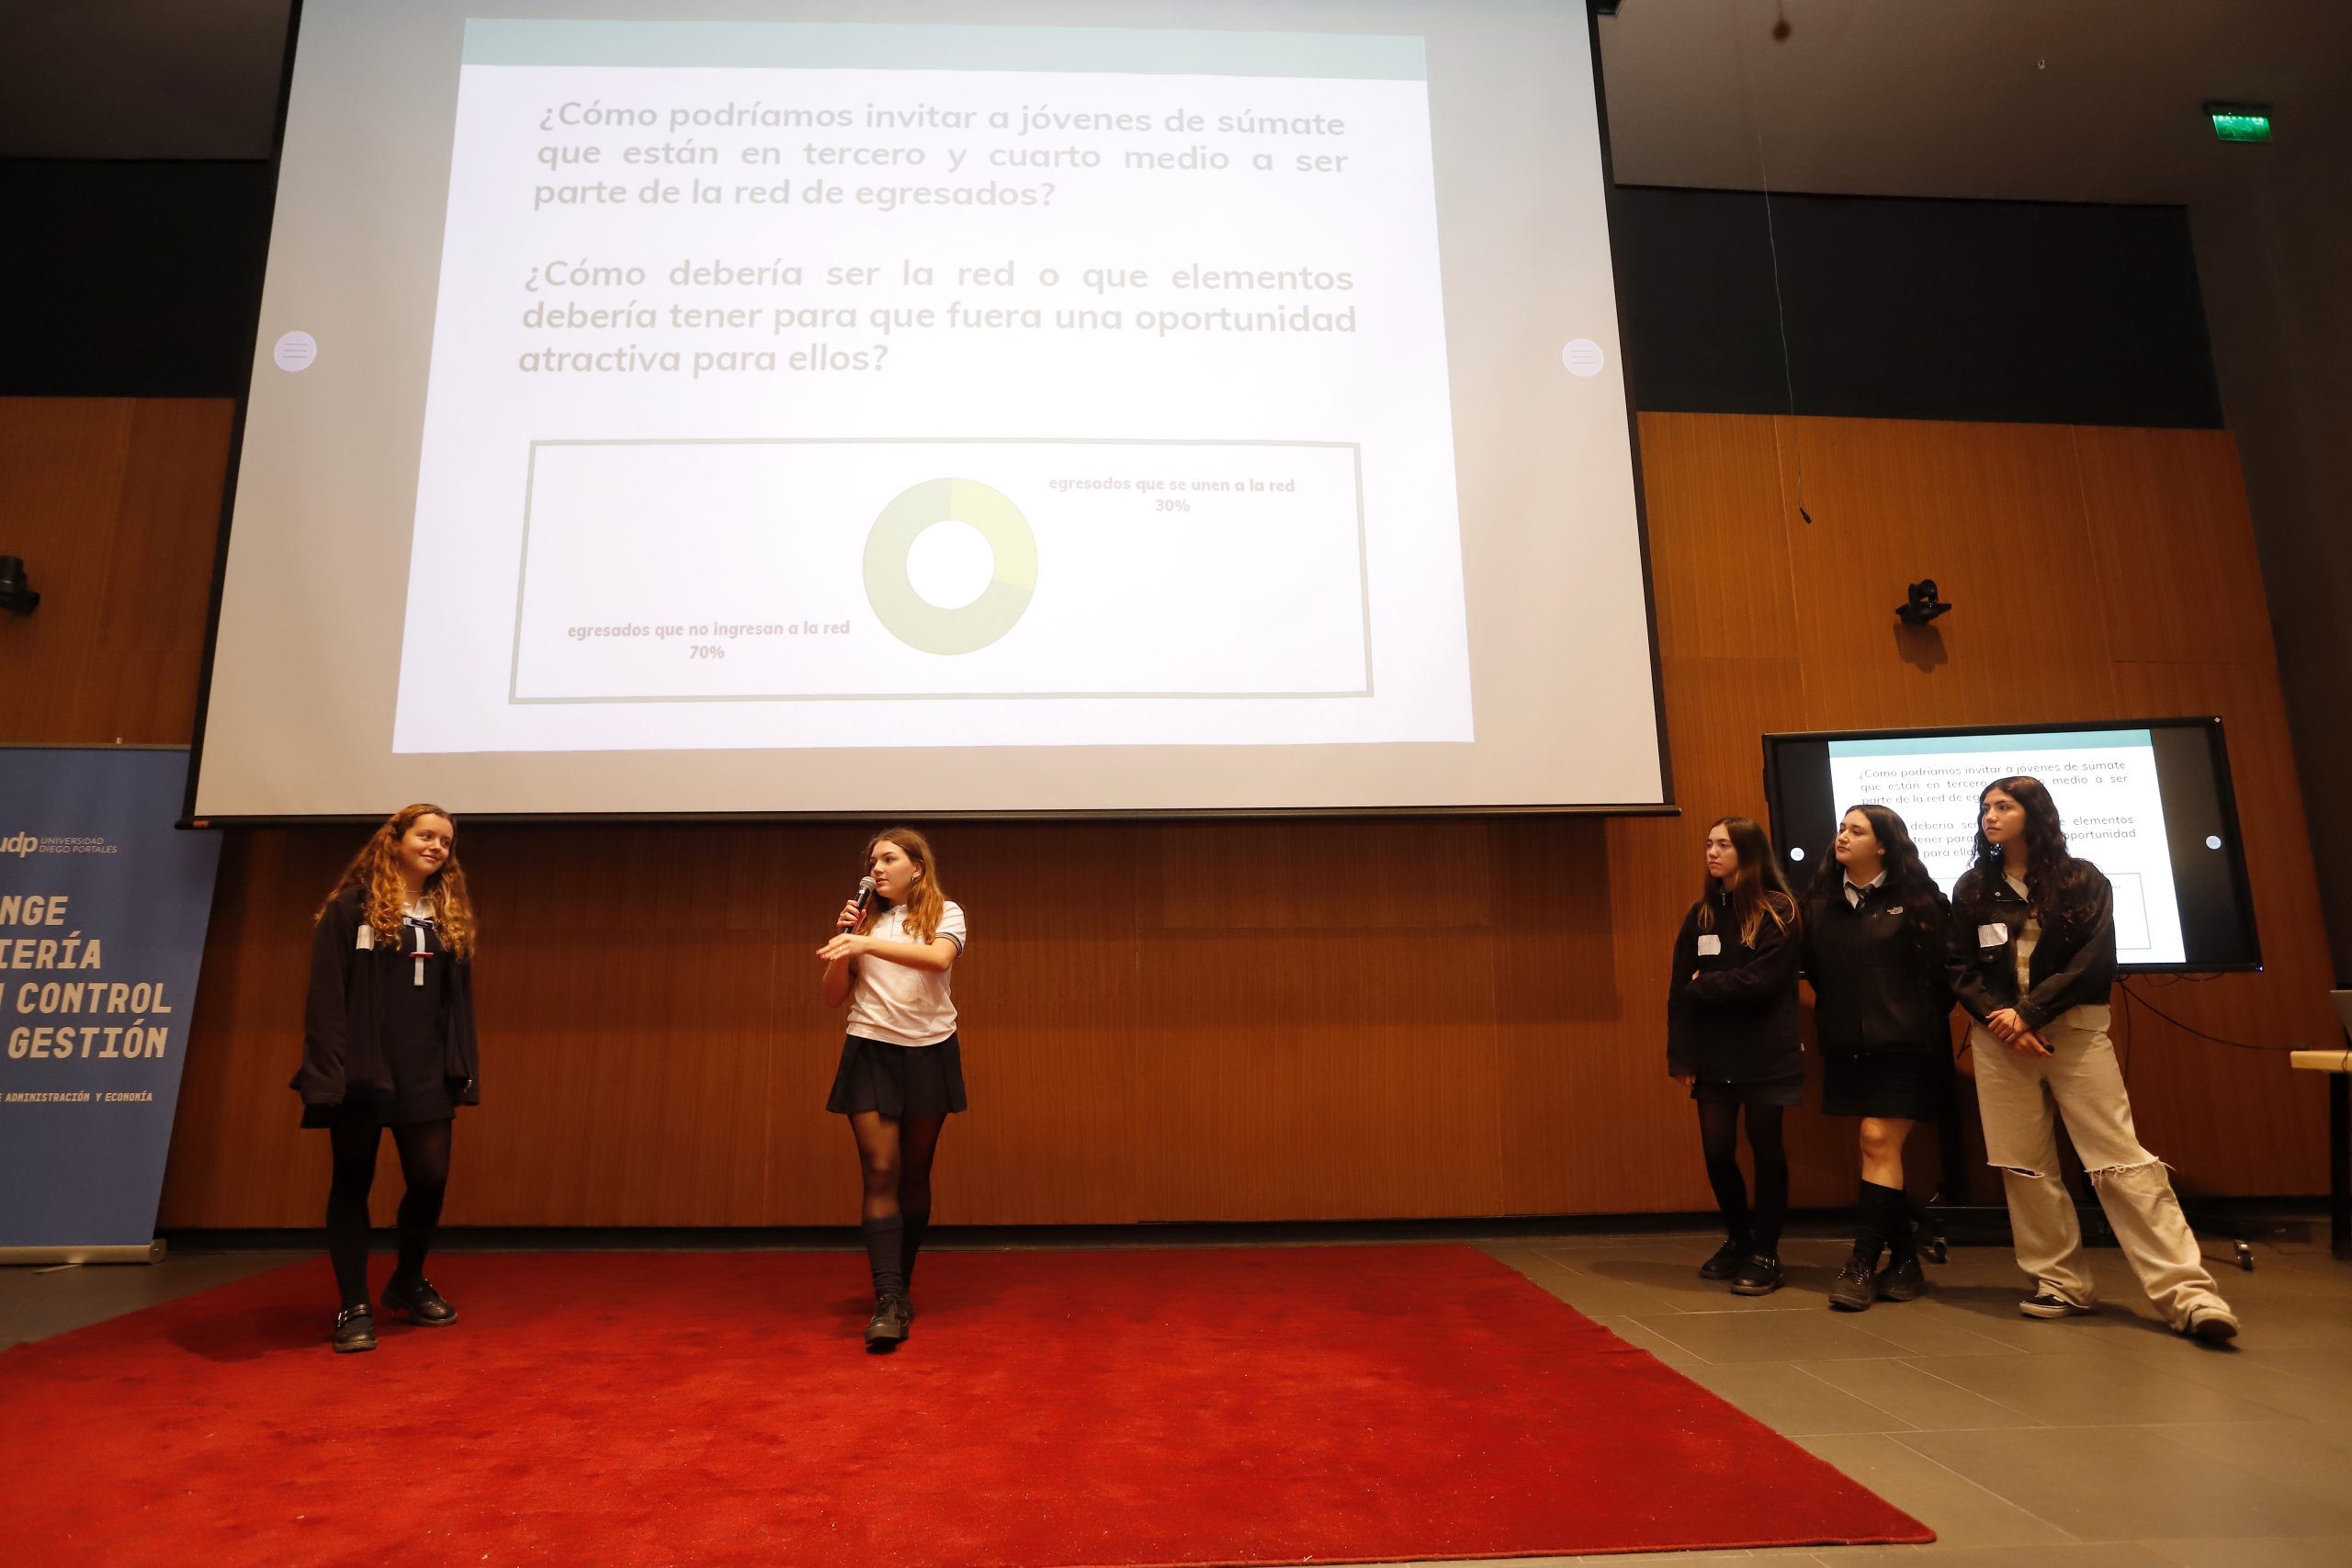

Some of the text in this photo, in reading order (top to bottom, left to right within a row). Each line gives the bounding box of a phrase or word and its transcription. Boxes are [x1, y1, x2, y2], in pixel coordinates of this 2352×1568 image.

[539, 99, 1344, 136] ¿Cómo podríamos invitar a jóvenes de súmate
[538, 138, 1348, 174] que están en tercero y cuarto medio a ser
[535, 178, 1056, 212] parte de la red de egresados?
[525, 258, 1353, 295] ¿Cómo debería ser la red o que elementos
[523, 299, 1356, 338] debería tener para que fuera una oportunidad
[519, 343, 888, 379] atractiva para ellos?
[1049, 477, 1295, 493] egresados que se unen a la red
[1156, 500, 1190, 512] 30%
[568, 620, 850, 641] egresados que no ingresan a la red
[690, 646, 725, 659] 70%
[1964, 763, 2001, 775] invitar
[2006, 765, 2013, 773] a
[2064, 761, 2078, 772] de
[1860, 784, 1882, 794] que
[1888, 780, 1920, 790] están
[1927, 781, 1940, 790] en
[1947, 779, 1987, 788] tercero
[2052, 775, 2088, 785] medio
[2110, 775, 2128, 784] ser
[1862, 796, 1893, 806] parte
[1895, 795, 1910, 804] de
[1913, 794, 1923, 803] la
[1927, 794, 1945, 803] red
[1949, 793, 1962, 802] de
[2073, 815, 2134, 826] elementos
[40, 837, 105, 846] UNIVERSIDAD
[1913, 835, 1943, 844] tener
[1947, 835, 1974, 845] para
[39, 844, 118, 853] DIEGO PORTALES
[1923, 850, 1951, 860] para
[17, 982, 172, 1014] CONTROL
[7, 1018, 168, 1059] GESTIÓN
[6, 1090, 90, 1102] ADMINISTRACIÓN
[96, 1092, 102, 1102] Y
[105, 1090, 153, 1102] ECONOMÍA
